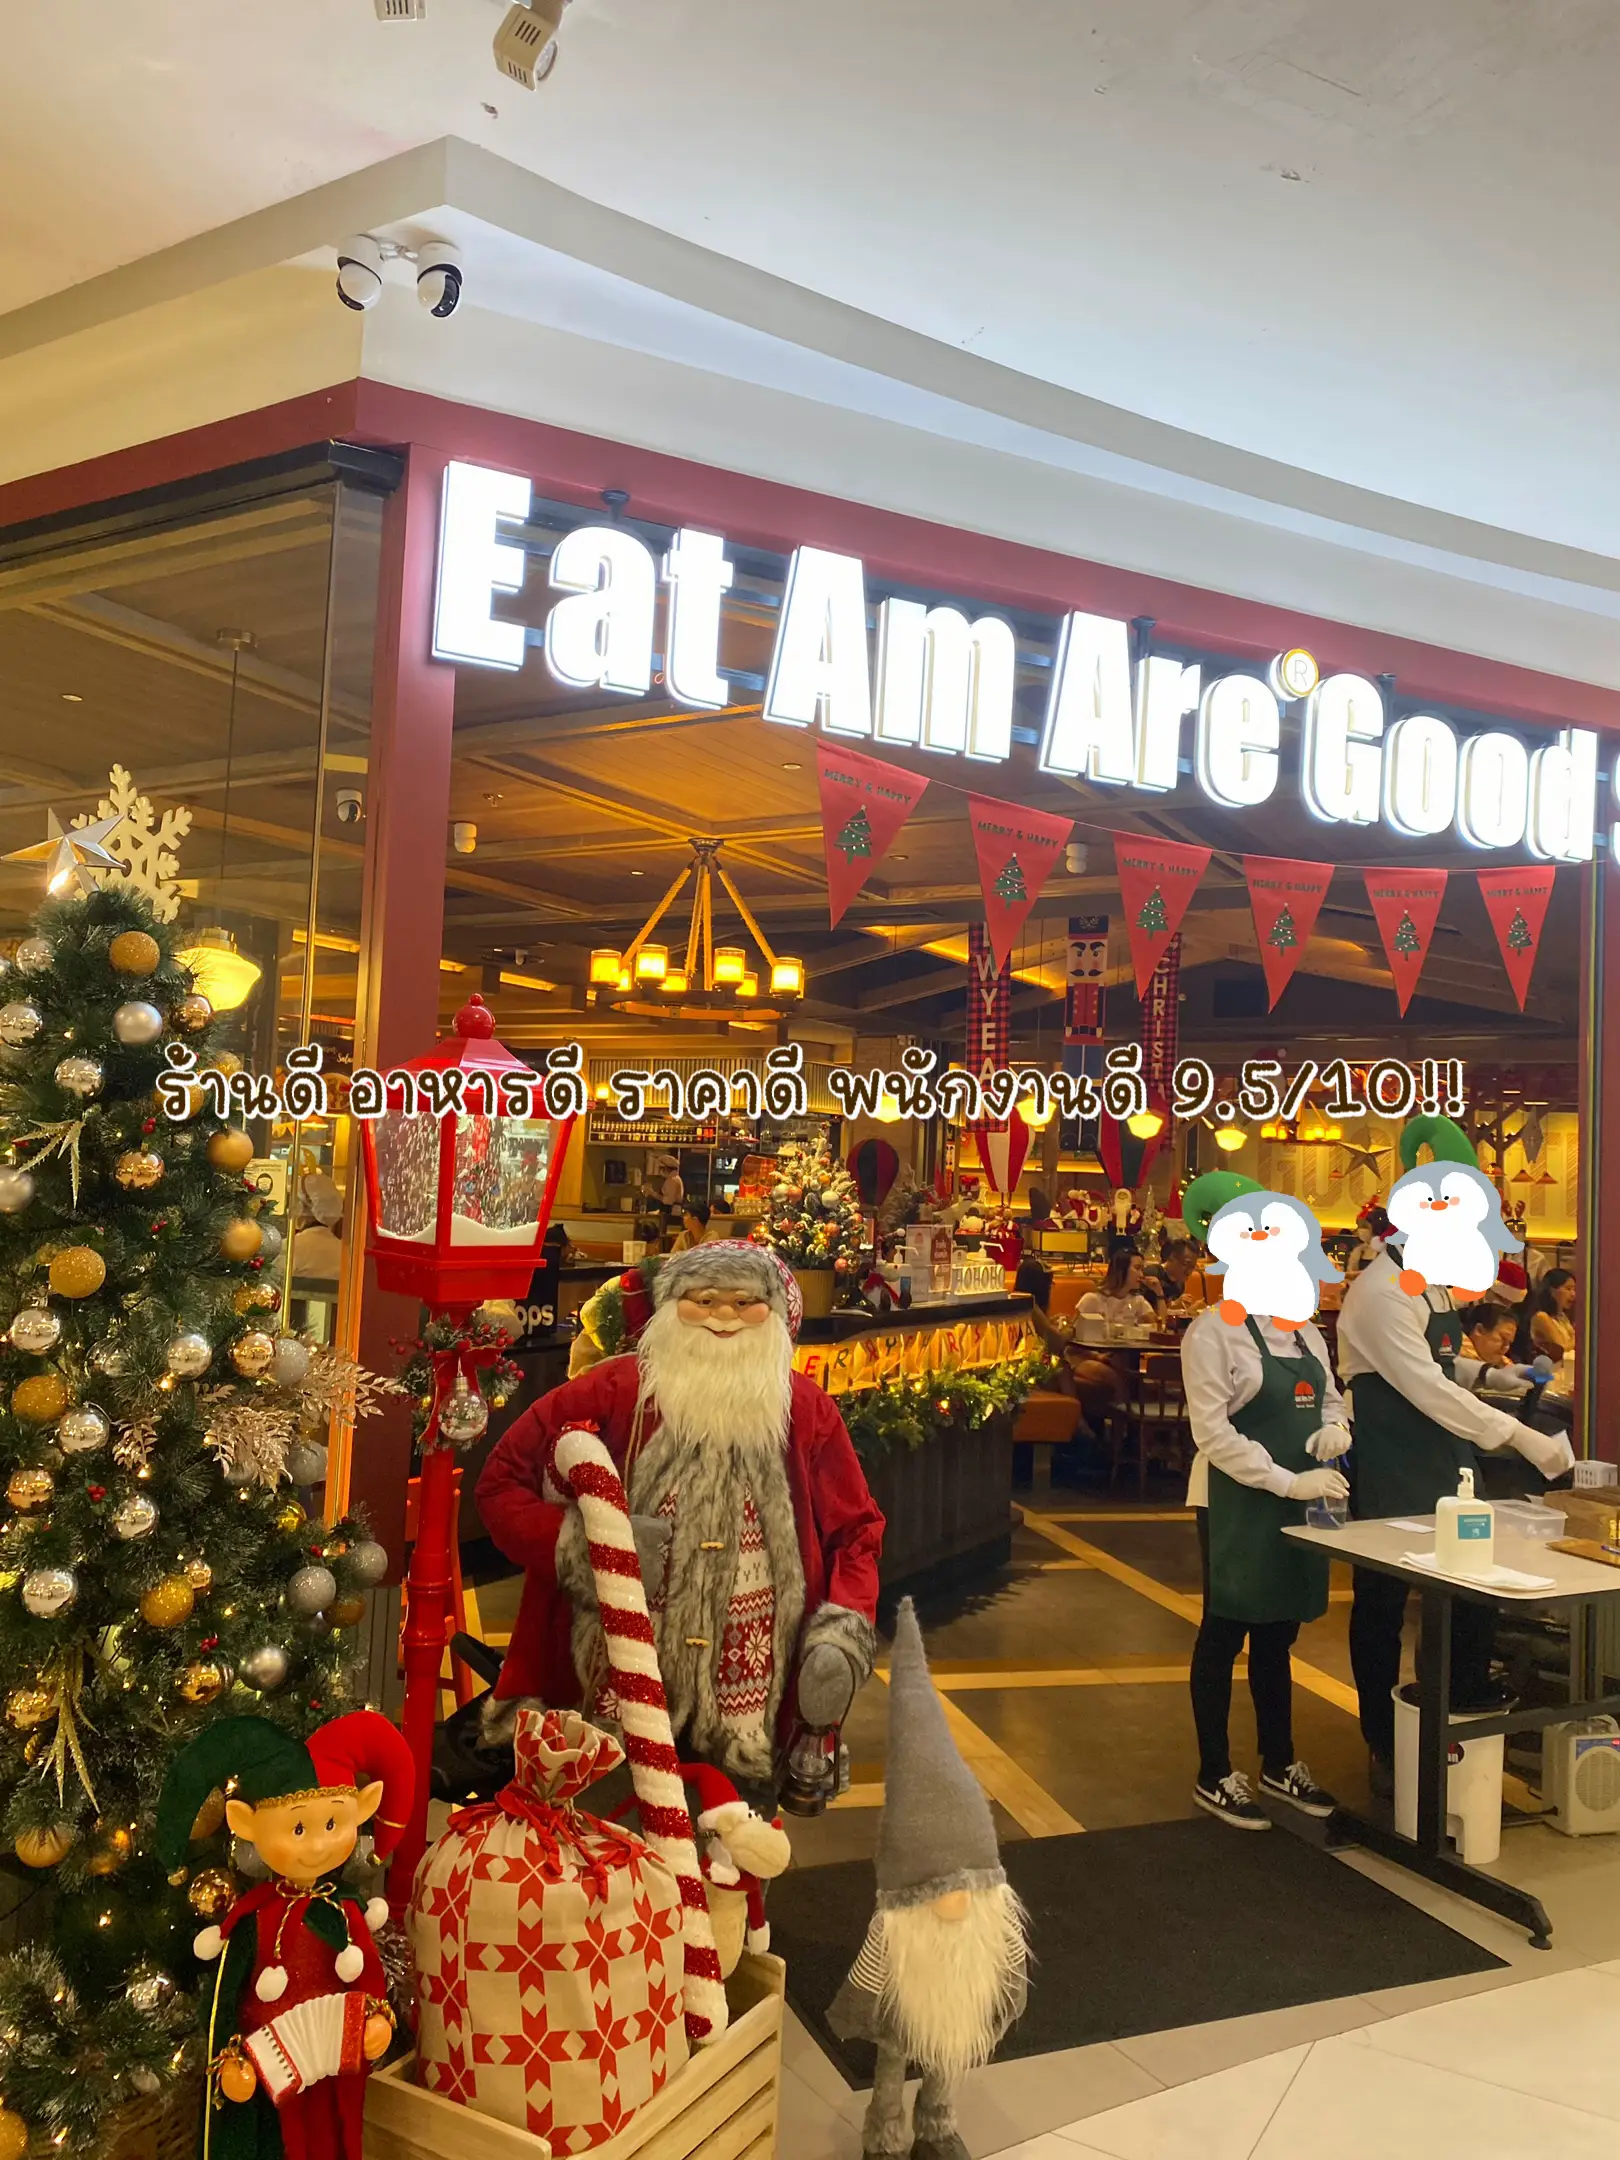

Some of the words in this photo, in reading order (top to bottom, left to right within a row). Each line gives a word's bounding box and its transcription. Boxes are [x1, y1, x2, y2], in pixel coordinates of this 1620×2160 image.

[432, 460, 733, 710] Eat
[762, 545, 1016, 764] Am
[1040, 610, 1281, 808] Are
[1302, 672, 1598, 863] Good
[823, 768, 862, 789] MERRY
[877, 786, 912, 805] HAPPY
[977, 820, 1014, 837] MERRY
[1026, 832, 1059, 848] HAPPY
[1122, 857, 1158, 871] MERRY
[1168, 865, 1199, 877] HAPPY
[1252, 878, 1283, 890] MERRY
[1293, 882, 1323, 893] HAPPY
